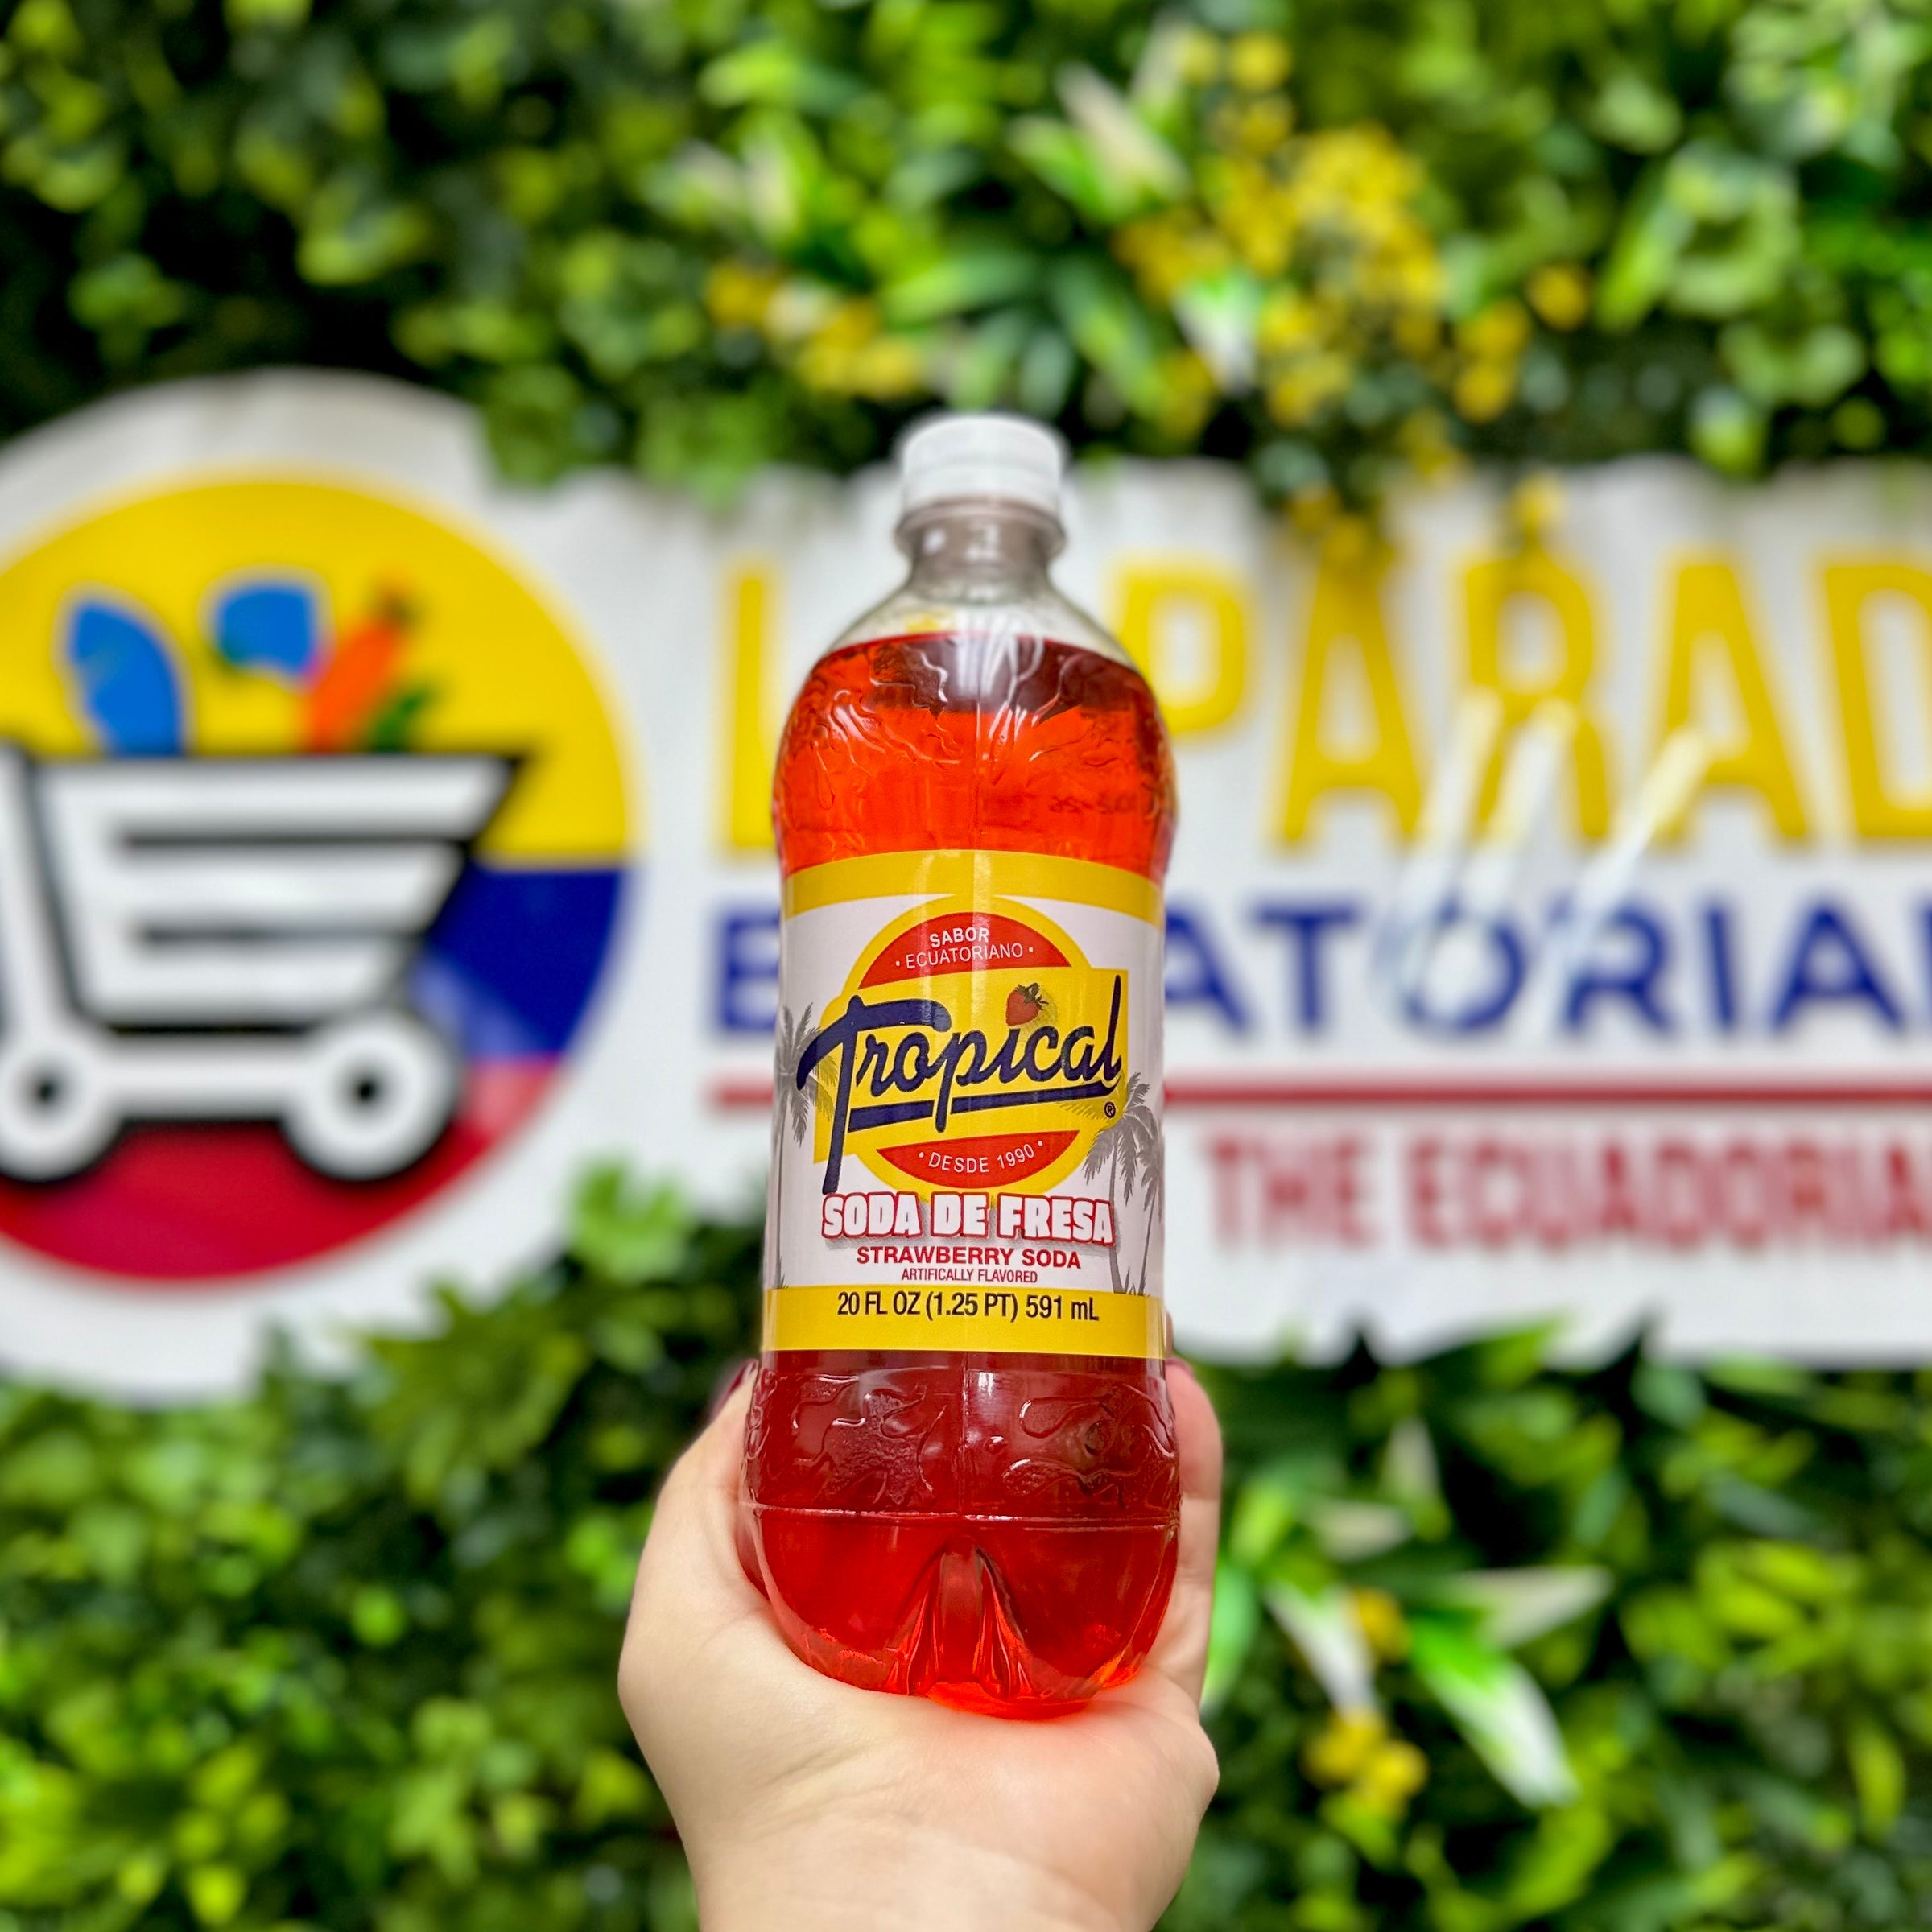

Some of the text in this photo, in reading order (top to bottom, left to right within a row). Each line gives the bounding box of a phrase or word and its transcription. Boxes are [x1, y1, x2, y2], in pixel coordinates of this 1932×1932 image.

[929, 927, 989, 948] SABOR
[906, 943, 1023, 969] ECUATORIANO
[796, 974, 1122, 1195] Tropical
[928, 1143, 1034, 1173] DESDE 1990
[1208, 1135, 1370, 1252] THE
[821, 1191, 1116, 1245] SODA DE FRESA
[857, 1245, 1081, 1269] STRAWBERRY SODA
[901, 1268, 1038, 1283] ARTIFICALLY FLAVORED
[837, 1290, 1100, 1323] 20 FL OZ (1.25 PT) 591 mL
